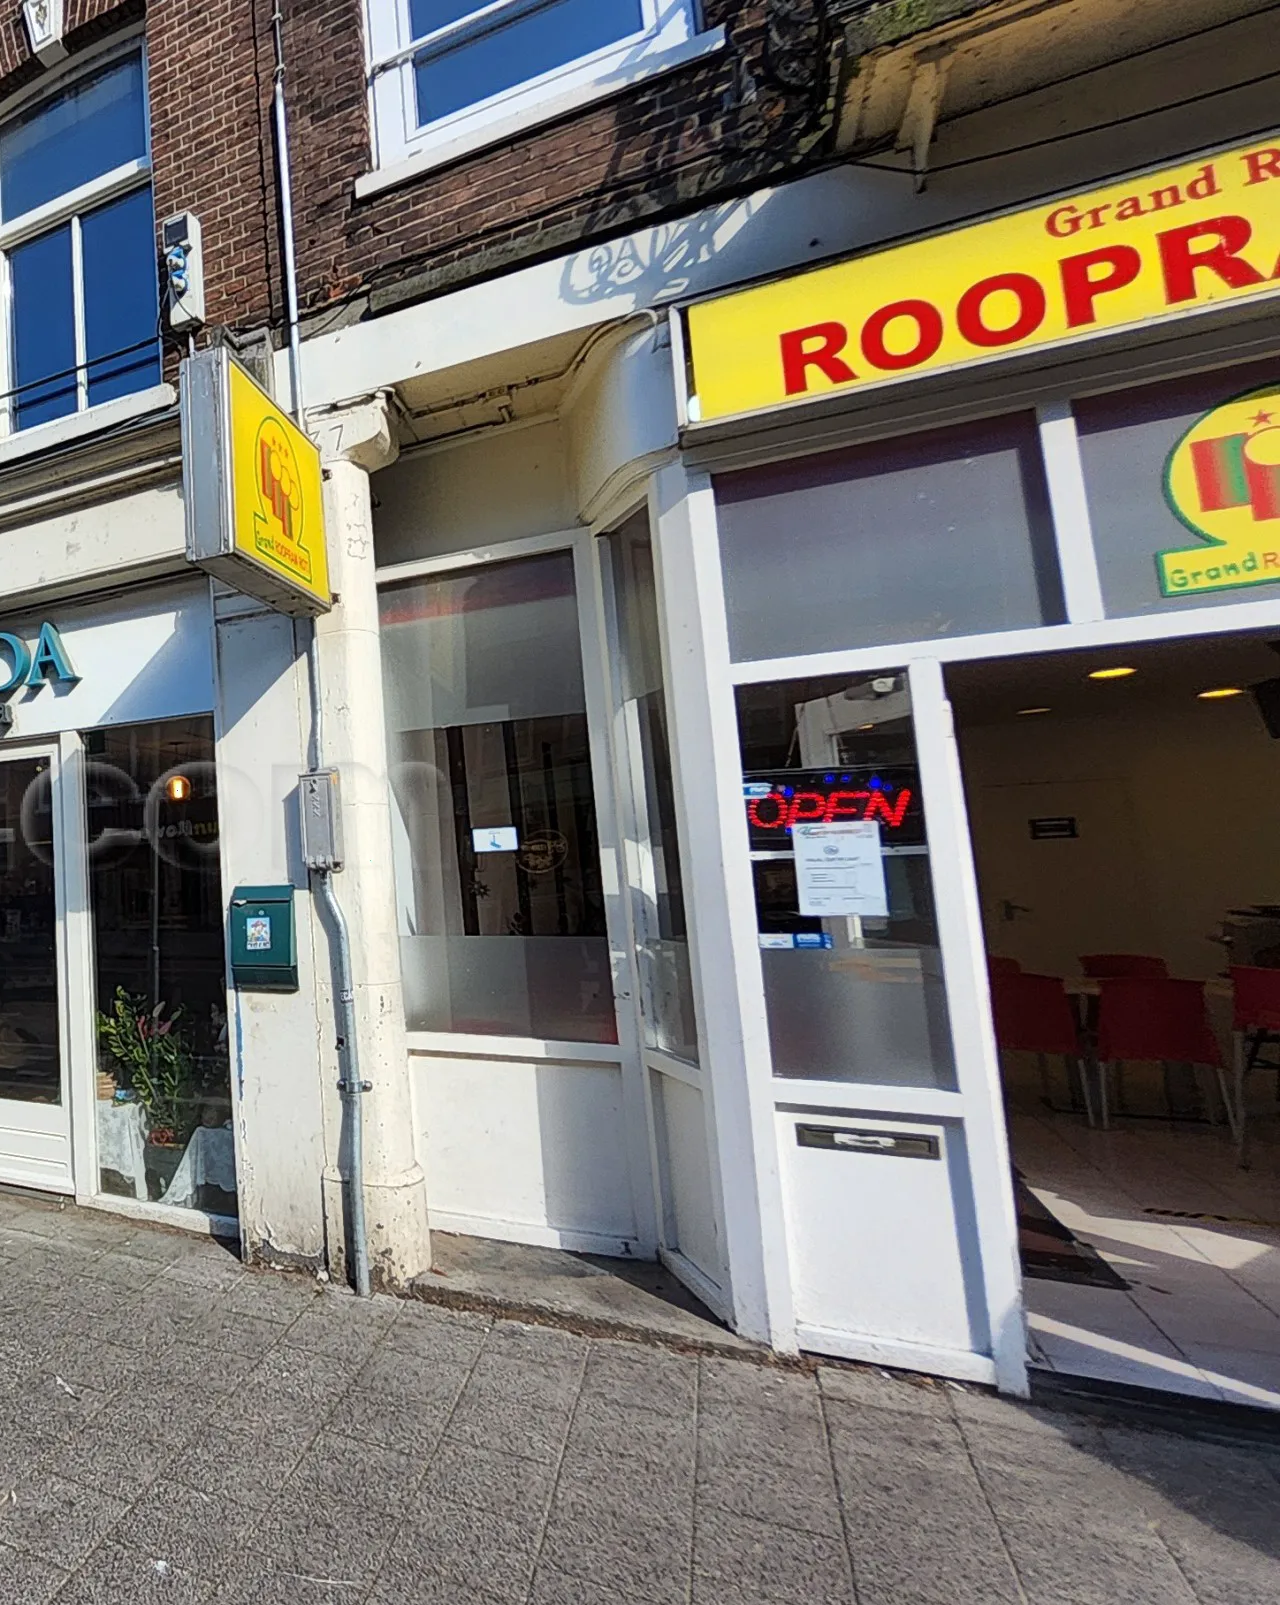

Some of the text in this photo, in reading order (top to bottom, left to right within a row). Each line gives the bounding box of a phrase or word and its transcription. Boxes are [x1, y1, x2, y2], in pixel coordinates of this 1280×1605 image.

[1045, 164, 1223, 238] Grand
[780, 215, 1280, 396] ROOPR
[1170, 551, 1259, 588] Grand
[748, 788, 912, 829] OPEN
